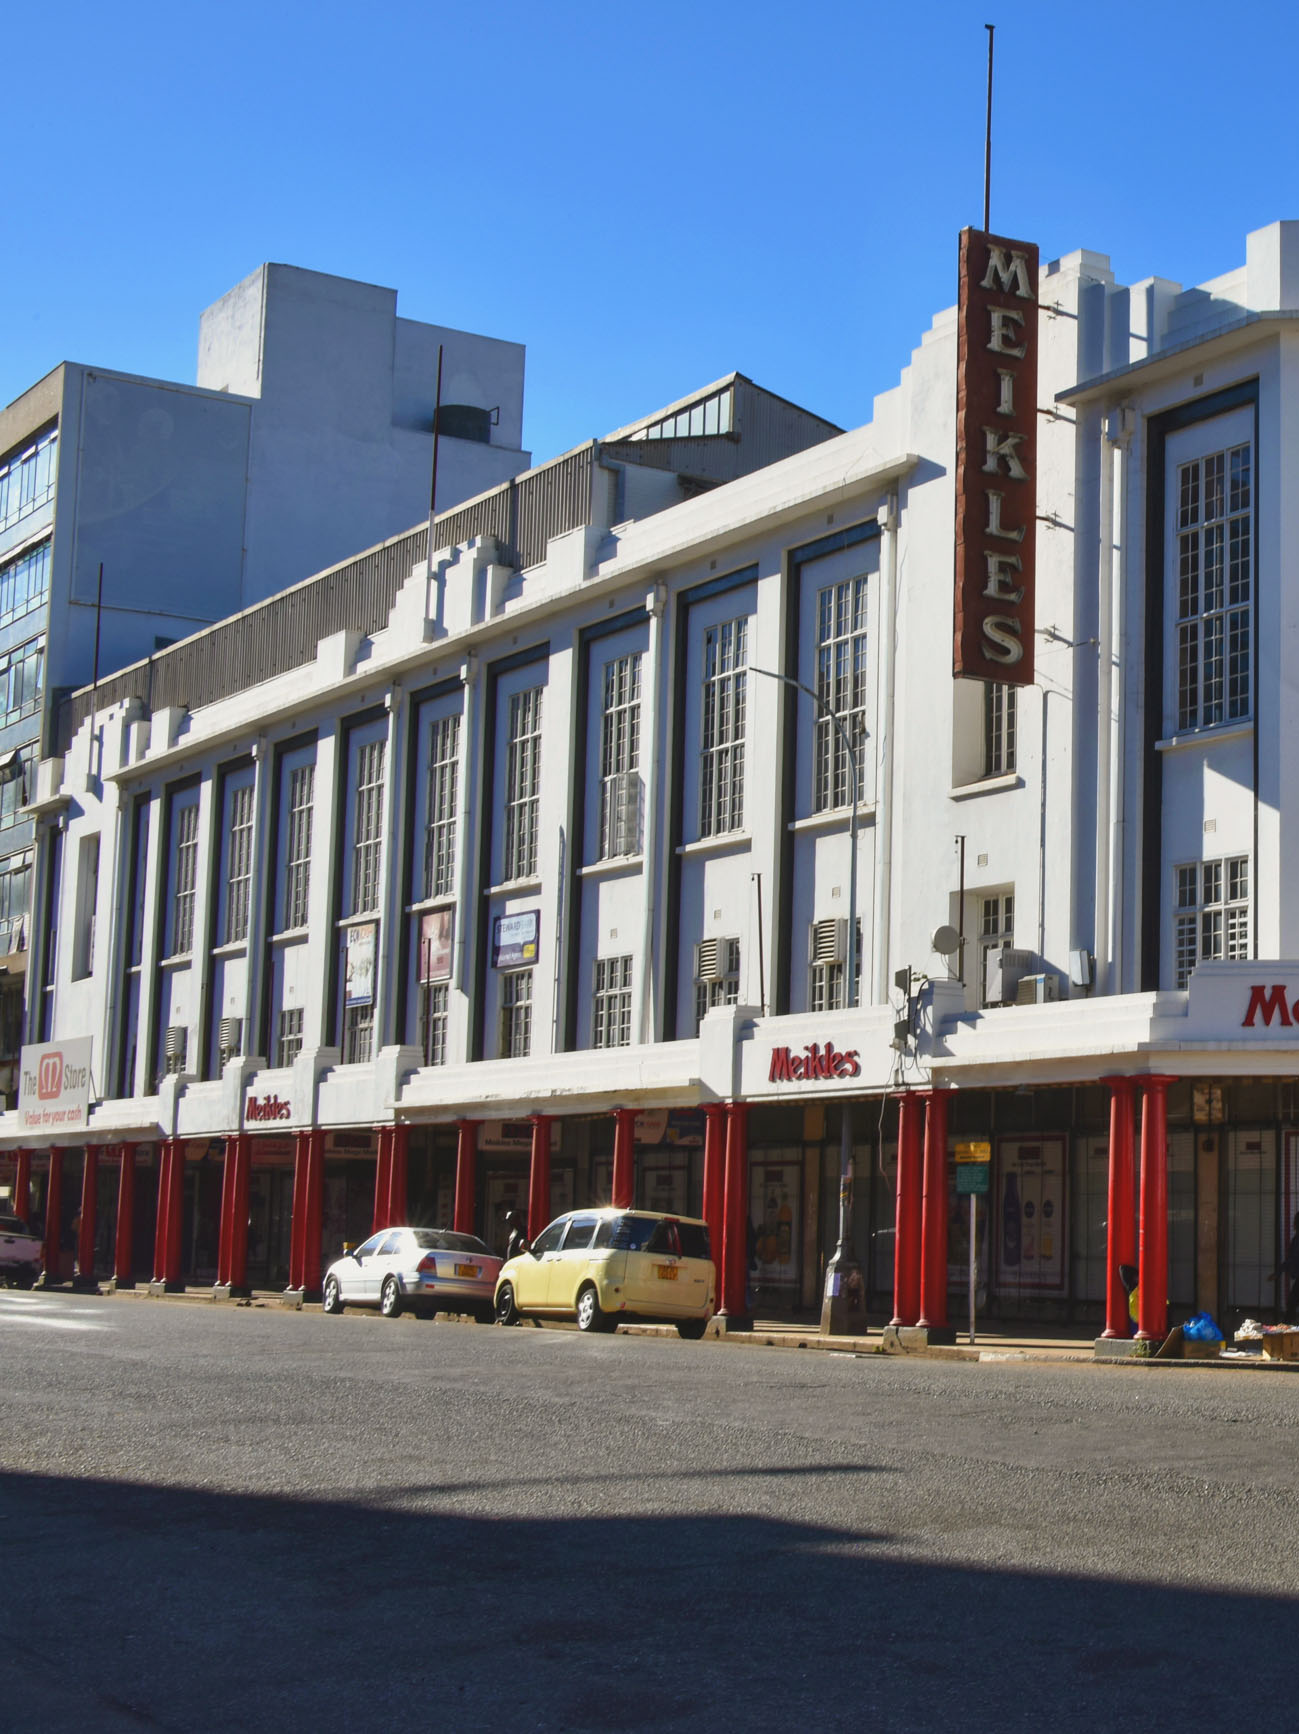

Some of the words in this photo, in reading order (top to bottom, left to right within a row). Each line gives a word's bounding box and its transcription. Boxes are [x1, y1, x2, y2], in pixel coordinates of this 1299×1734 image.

[978, 242, 1035, 665] MEIKLES
[768, 1040, 861, 1083] Meikles
[24, 1071, 37, 1096] The
[63, 1064, 87, 1091] Store
[51, 1110, 66, 1125] your
[67, 1104, 82, 1120] cash
[246, 1094, 291, 1122] Meikles
